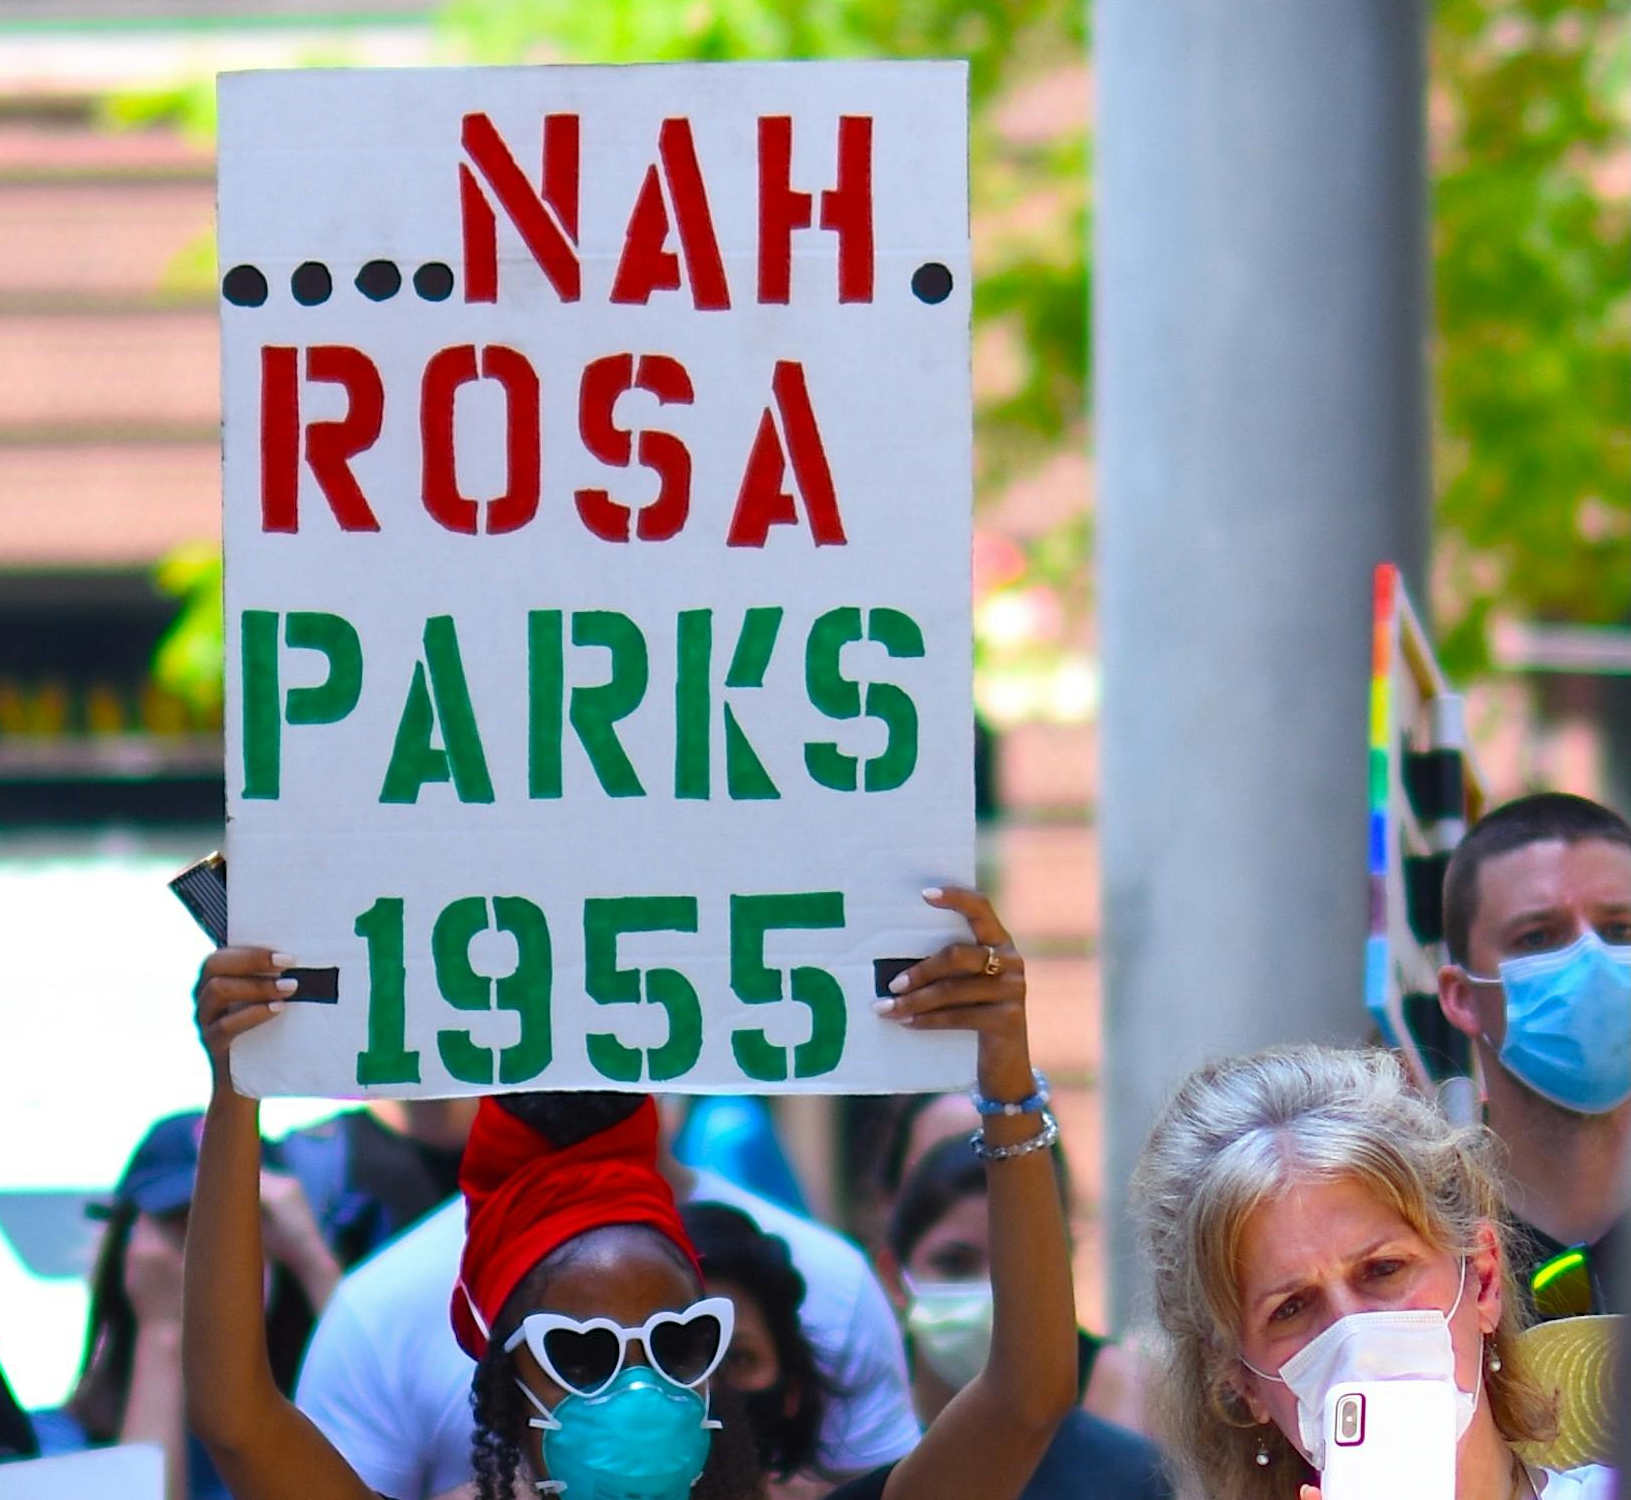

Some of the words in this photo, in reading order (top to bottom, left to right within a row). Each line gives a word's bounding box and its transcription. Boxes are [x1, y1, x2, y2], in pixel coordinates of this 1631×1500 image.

[260, 343, 848, 548] ROSA
[241, 605, 926, 804] PARKS
[355, 891, 849, 1086] 1955
